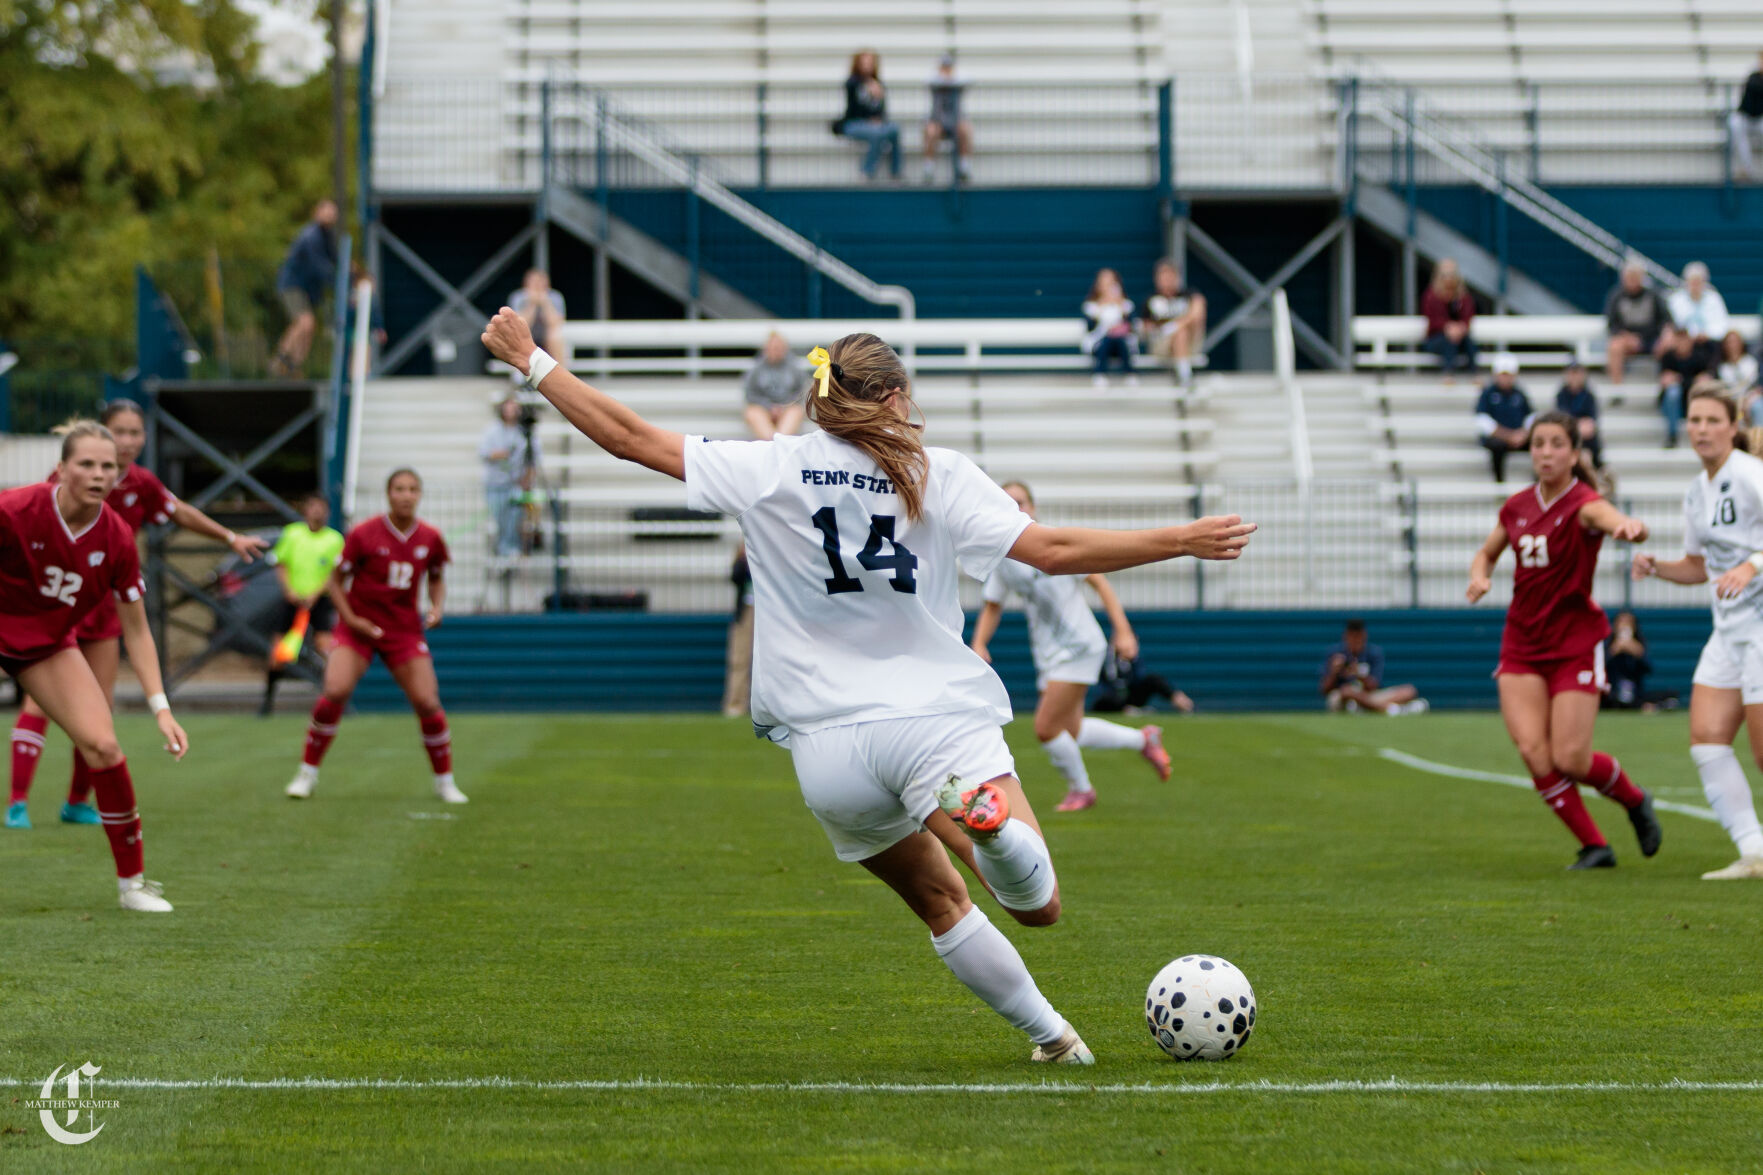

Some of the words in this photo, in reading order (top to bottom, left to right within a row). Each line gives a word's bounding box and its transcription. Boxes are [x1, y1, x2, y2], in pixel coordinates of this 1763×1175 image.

[801, 469, 850, 486] PENN
[853, 473, 897, 494] STAT
[1711, 498, 1737, 527] 10
[811, 506, 918, 595] 14
[1519, 533, 1550, 568] 23
[40, 565, 83, 607] 32
[388, 560, 414, 590] 12
